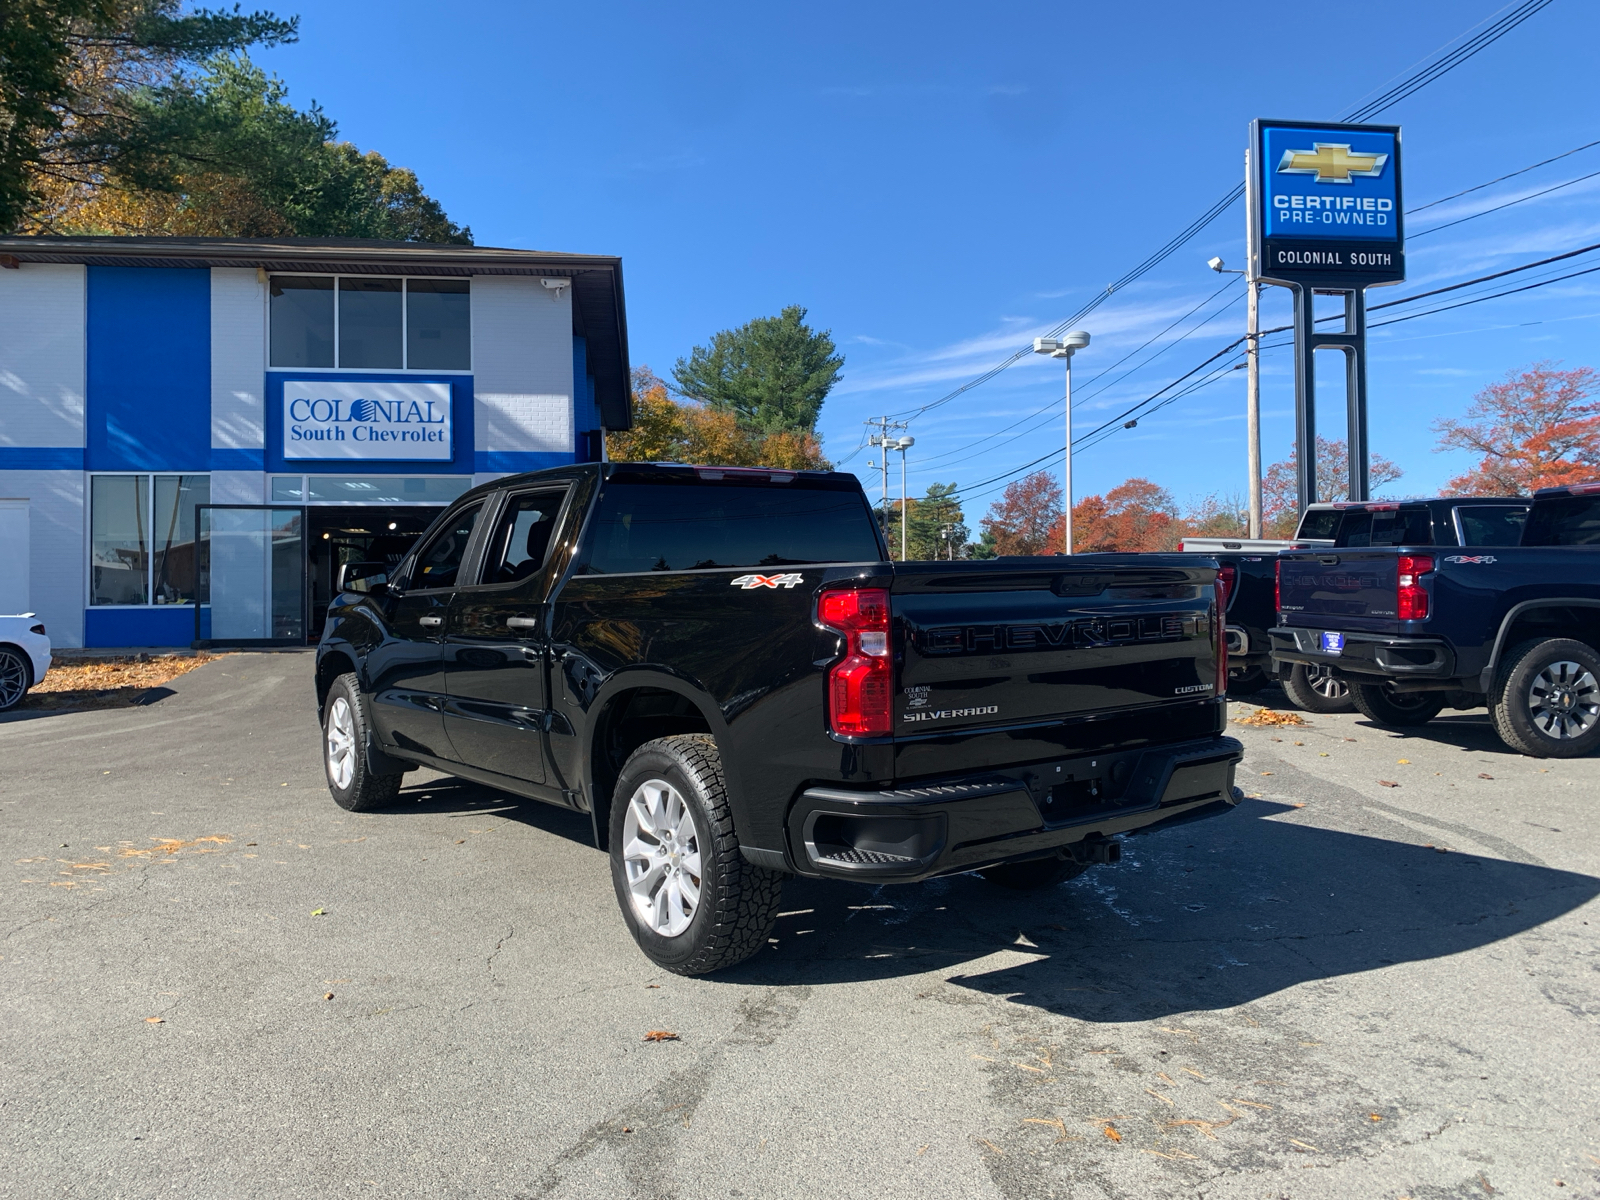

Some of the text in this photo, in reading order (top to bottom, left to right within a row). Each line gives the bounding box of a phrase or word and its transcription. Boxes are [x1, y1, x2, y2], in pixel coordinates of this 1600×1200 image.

[1273, 195, 1392, 211] CERTIFIED
[1280, 210, 1387, 225] PRE-OWNED
[1278, 251, 1391, 265] COLONIAL SOUTH
[289, 398, 445, 424] COLONIAL
[291, 424, 445, 443] South Chevrolet
[908, 692, 928, 700] SOUTH
[1174, 683, 1213, 694] CUSTOM
[903, 705, 998, 722] SILVERADO
